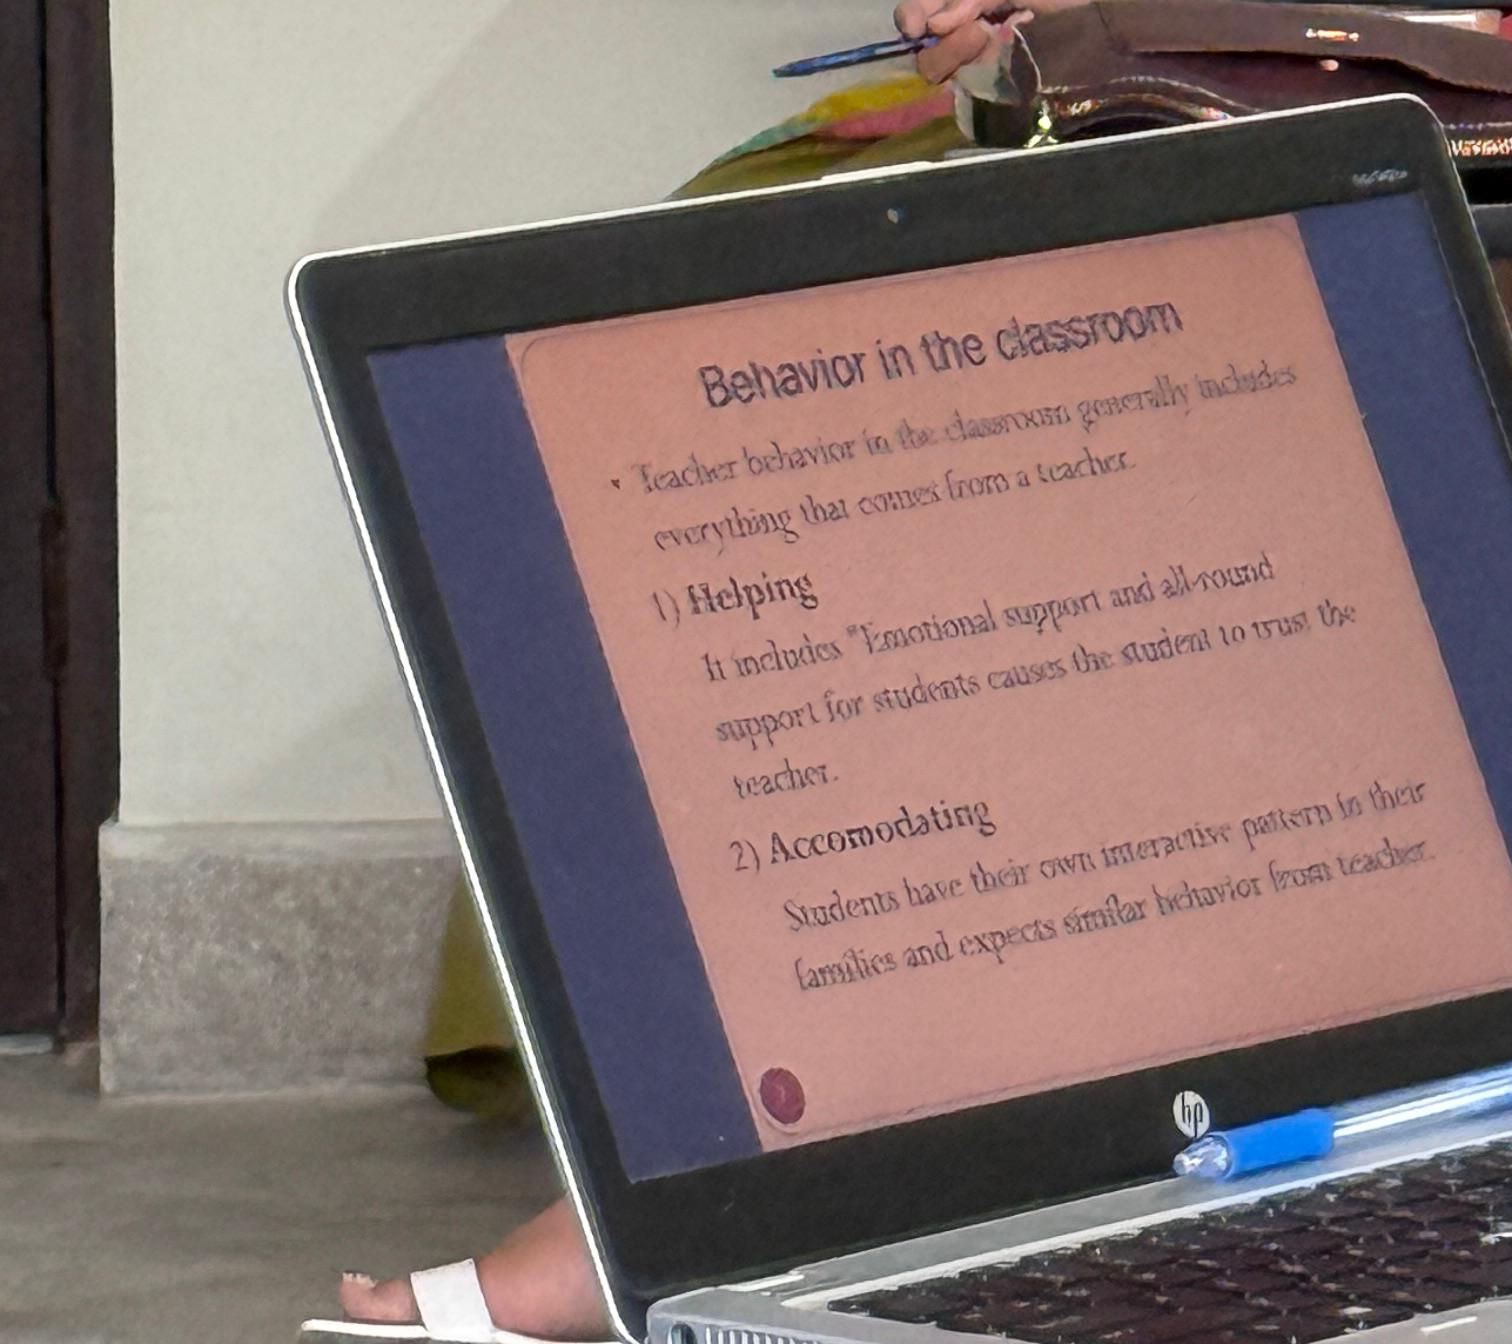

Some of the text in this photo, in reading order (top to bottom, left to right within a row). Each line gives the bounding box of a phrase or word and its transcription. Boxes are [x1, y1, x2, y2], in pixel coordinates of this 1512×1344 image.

[699, 302, 1184, 408] Behavior in the classroom
[633, 360, 1297, 494] Teacher behavior in the classroom generally includes
[654, 447, 1137, 556] everything that comes from a teacher.
[688, 572, 819, 621] Helping
[702, 652, 726, 682] It
[735, 633, 843, 678] includes
[1003, 591, 1101, 635] support
[1109, 571, 1156, 609] and
[716, 599, 1357, 751] support for students causes the student to trust the
[733, 758, 839, 800] teacher.
[730, 800, 997, 875] 2) Accomodating
[782, 888, 900, 932] Students
[903, 876, 964, 908] have
[970, 859, 1031, 894] their
[1039, 852, 1097, 880] own
[1101, 821, 1232, 868] interactive
[1241, 804, 1333, 852] pattern
[1368, 780, 1427, 813] their
[794, 948, 897, 991] families
[906, 930, 954, 967] and
[959, 918, 1057, 965] expects
[1062, 893, 1147, 937] similar
[1151, 874, 1262, 917] behavior
[1268, 859, 1334, 894] from
[1180, 1092, 1205, 1139] hp
